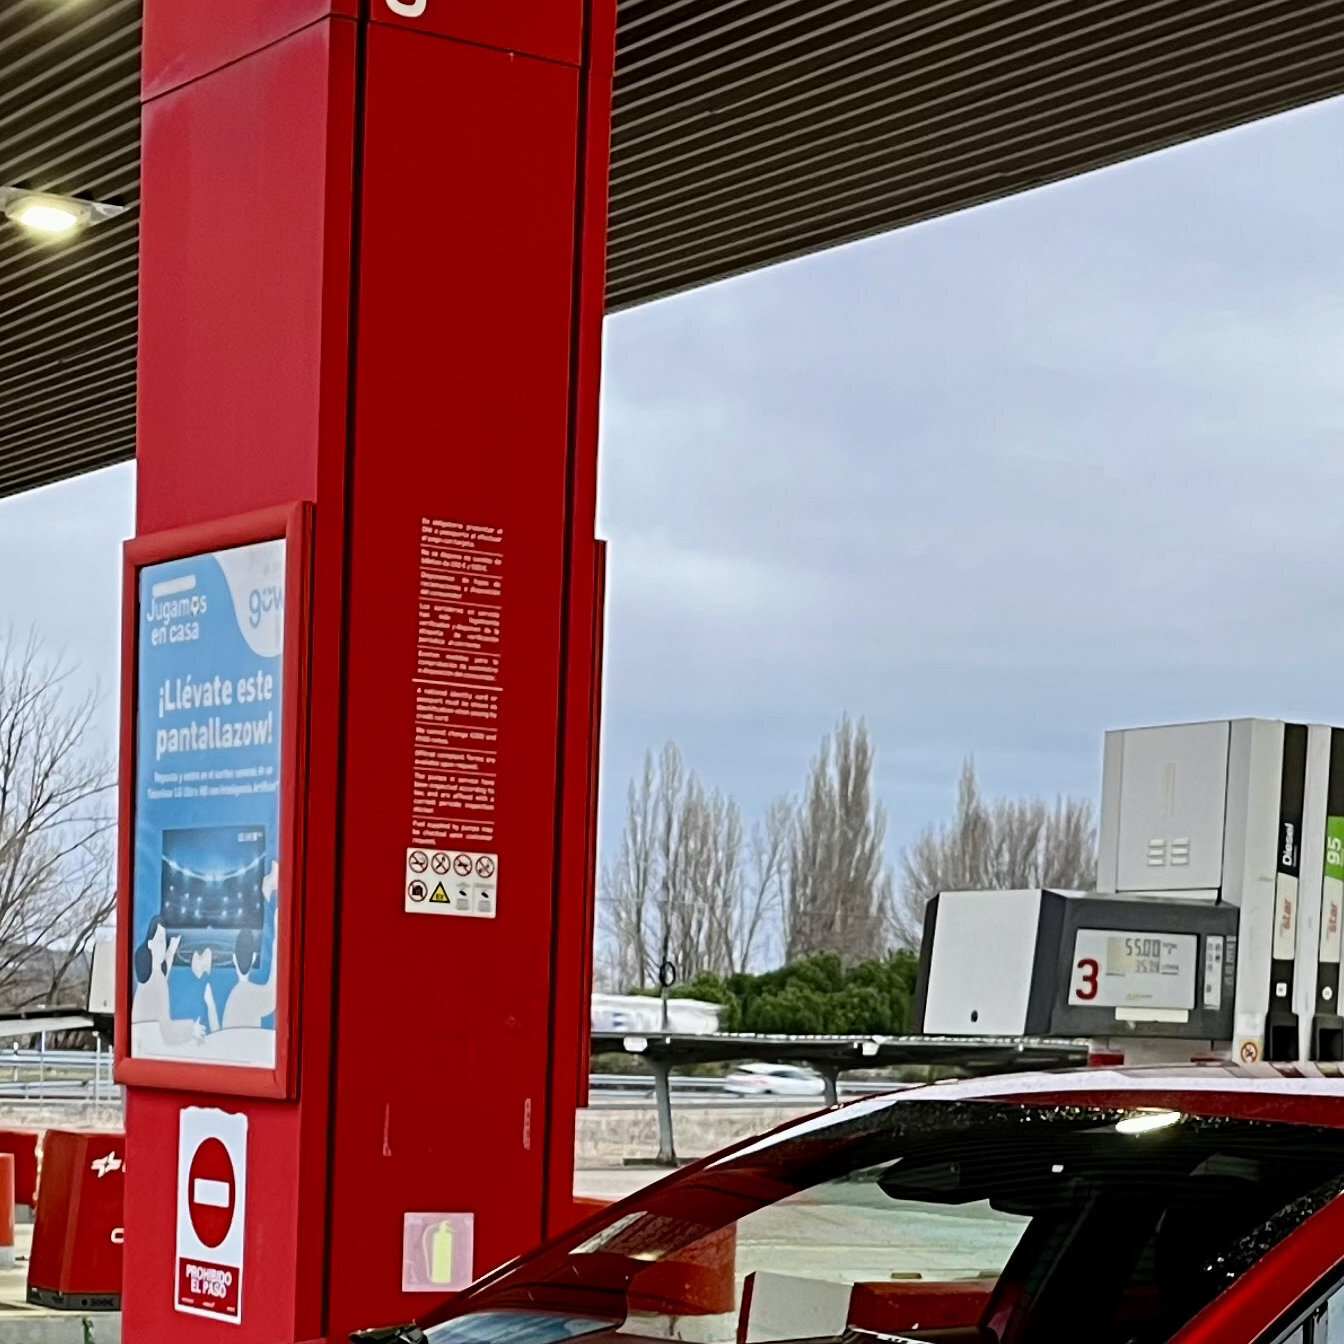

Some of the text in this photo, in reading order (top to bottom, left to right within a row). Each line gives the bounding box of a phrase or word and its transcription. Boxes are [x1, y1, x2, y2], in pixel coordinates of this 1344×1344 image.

[146, 594, 207, 625] Jugamos
[151, 620, 199, 646] en casa
[159, 669, 273, 718] ¡Llévate este
[156, 711, 273, 761] pantallazow!
[1282, 822, 1294, 866] Diesel
[1327, 836, 1342, 865] 95
[1075, 958, 1100, 1000] 3
